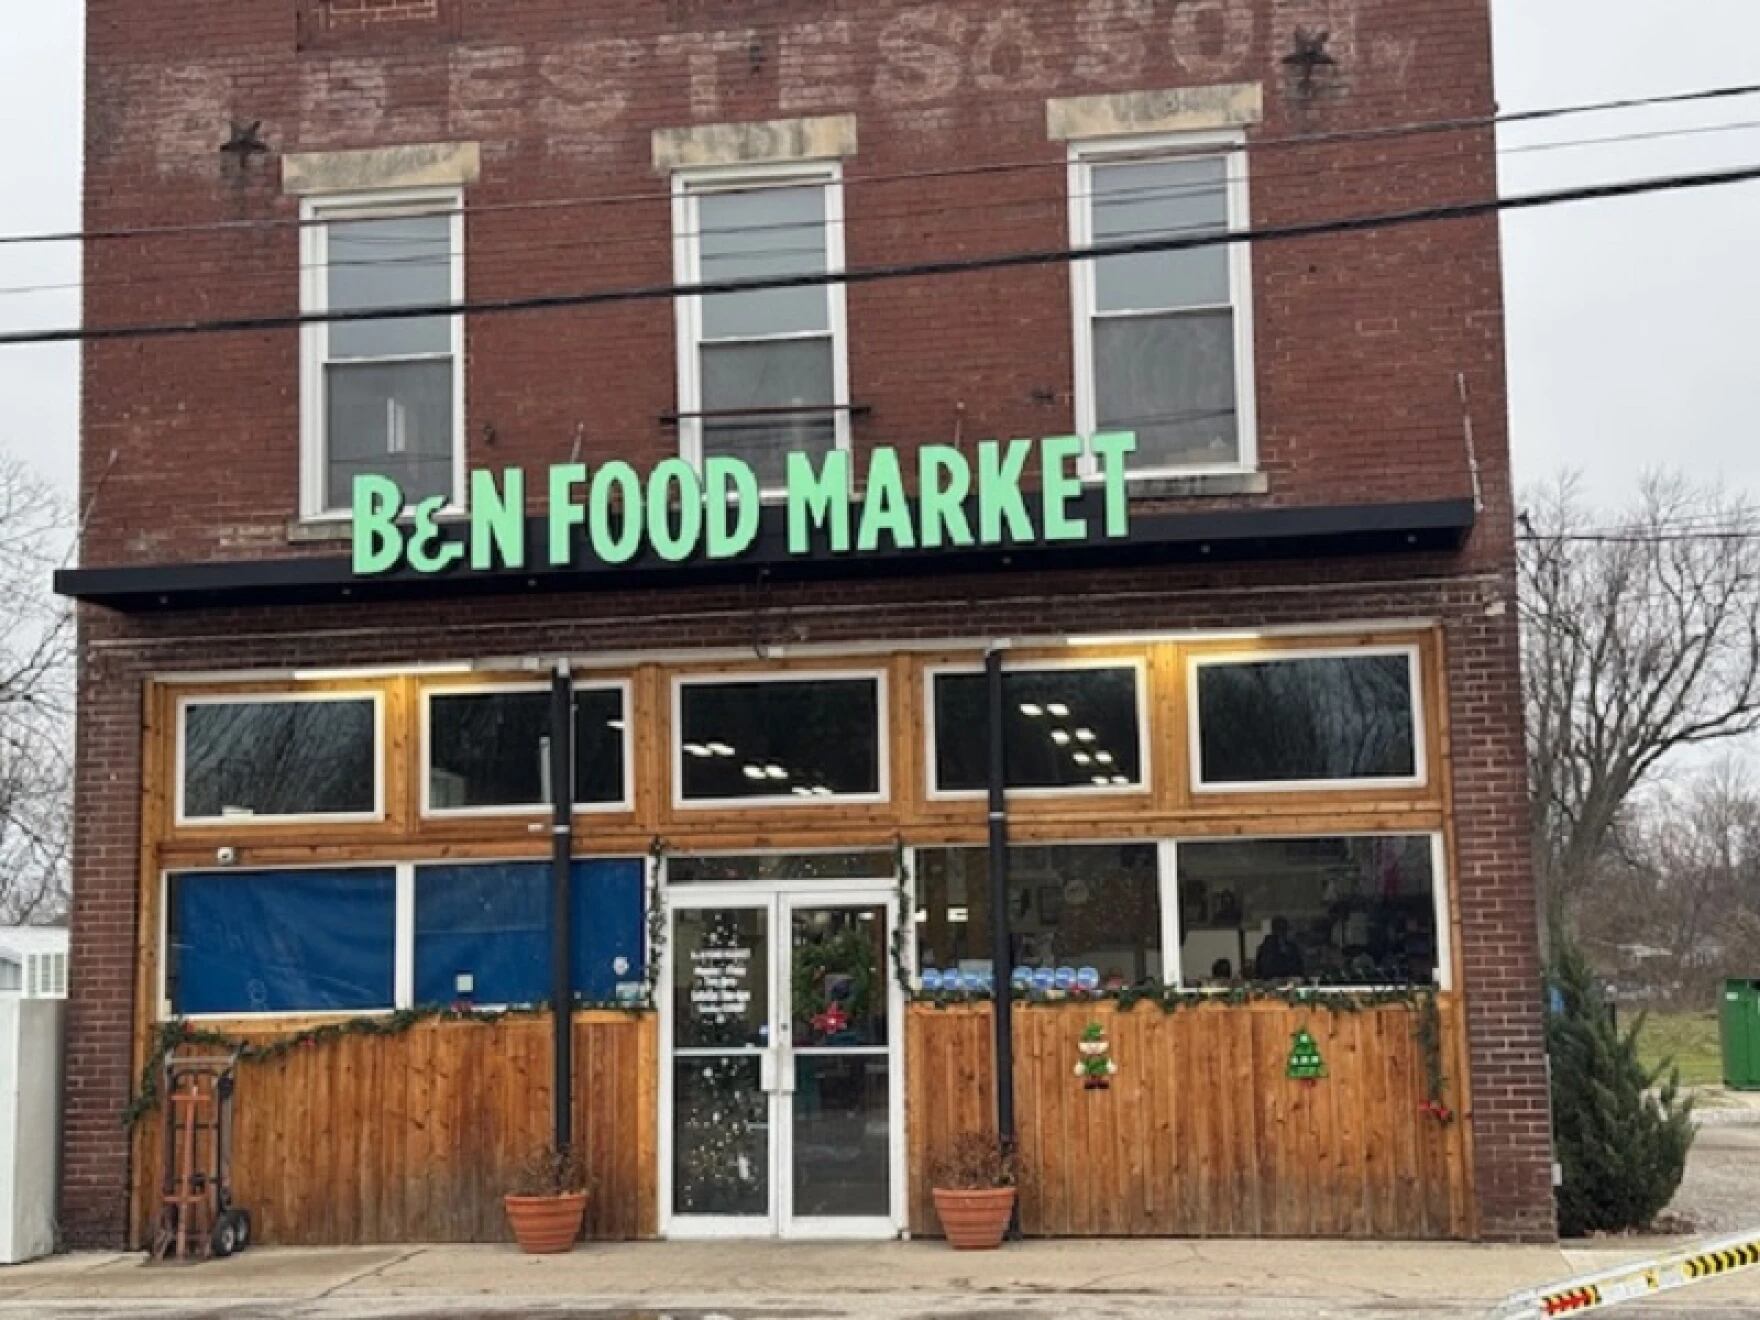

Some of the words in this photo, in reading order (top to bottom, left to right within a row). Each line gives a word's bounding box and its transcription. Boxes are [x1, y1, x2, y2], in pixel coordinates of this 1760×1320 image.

[352, 467, 524, 575] B&N
[549, 456, 760, 564] FOOD
[787, 430, 1136, 553] MARKET
